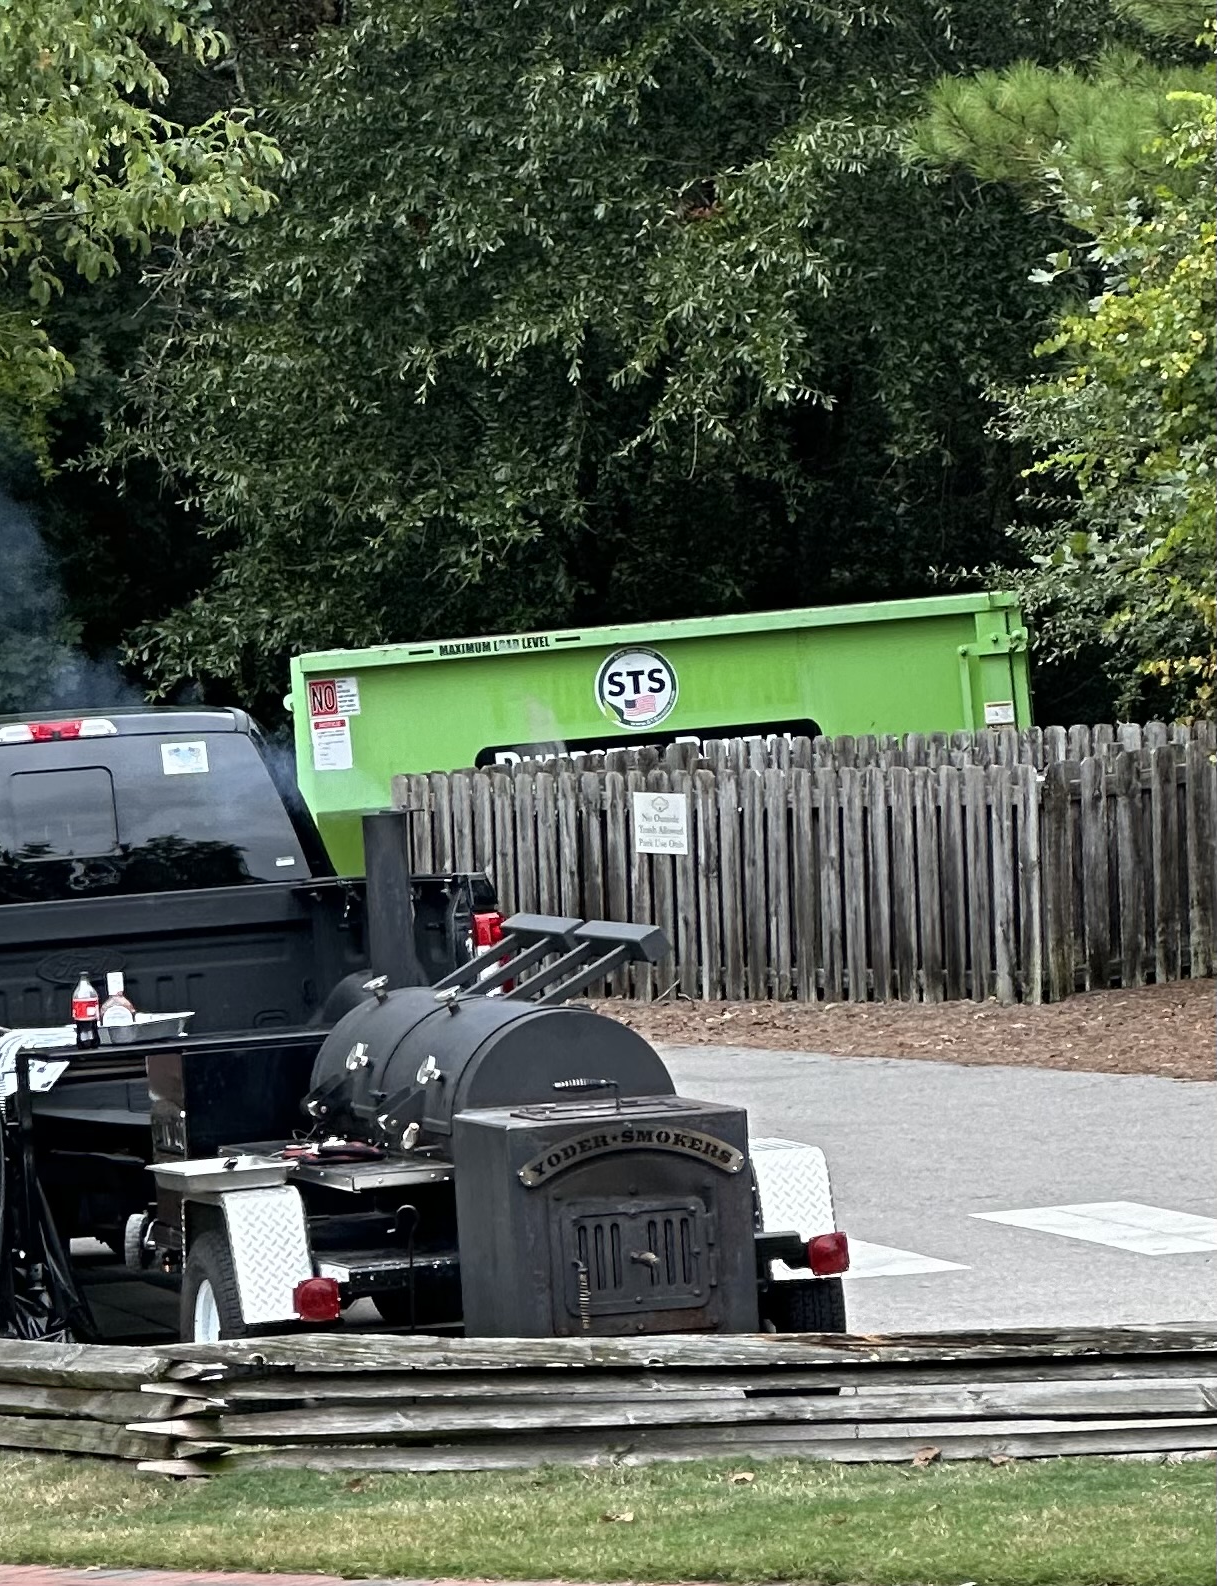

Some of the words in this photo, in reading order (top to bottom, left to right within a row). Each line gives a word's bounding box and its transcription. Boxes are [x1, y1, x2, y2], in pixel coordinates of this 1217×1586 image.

[439, 641, 492, 656] MAXIMUM
[522, 636, 550, 650] LEVEL
[607, 668, 666, 697] STS
[311, 685, 335, 712] NO
[530, 1134, 610, 1178] YODER
[620, 1128, 734, 1165] SMOKERS
